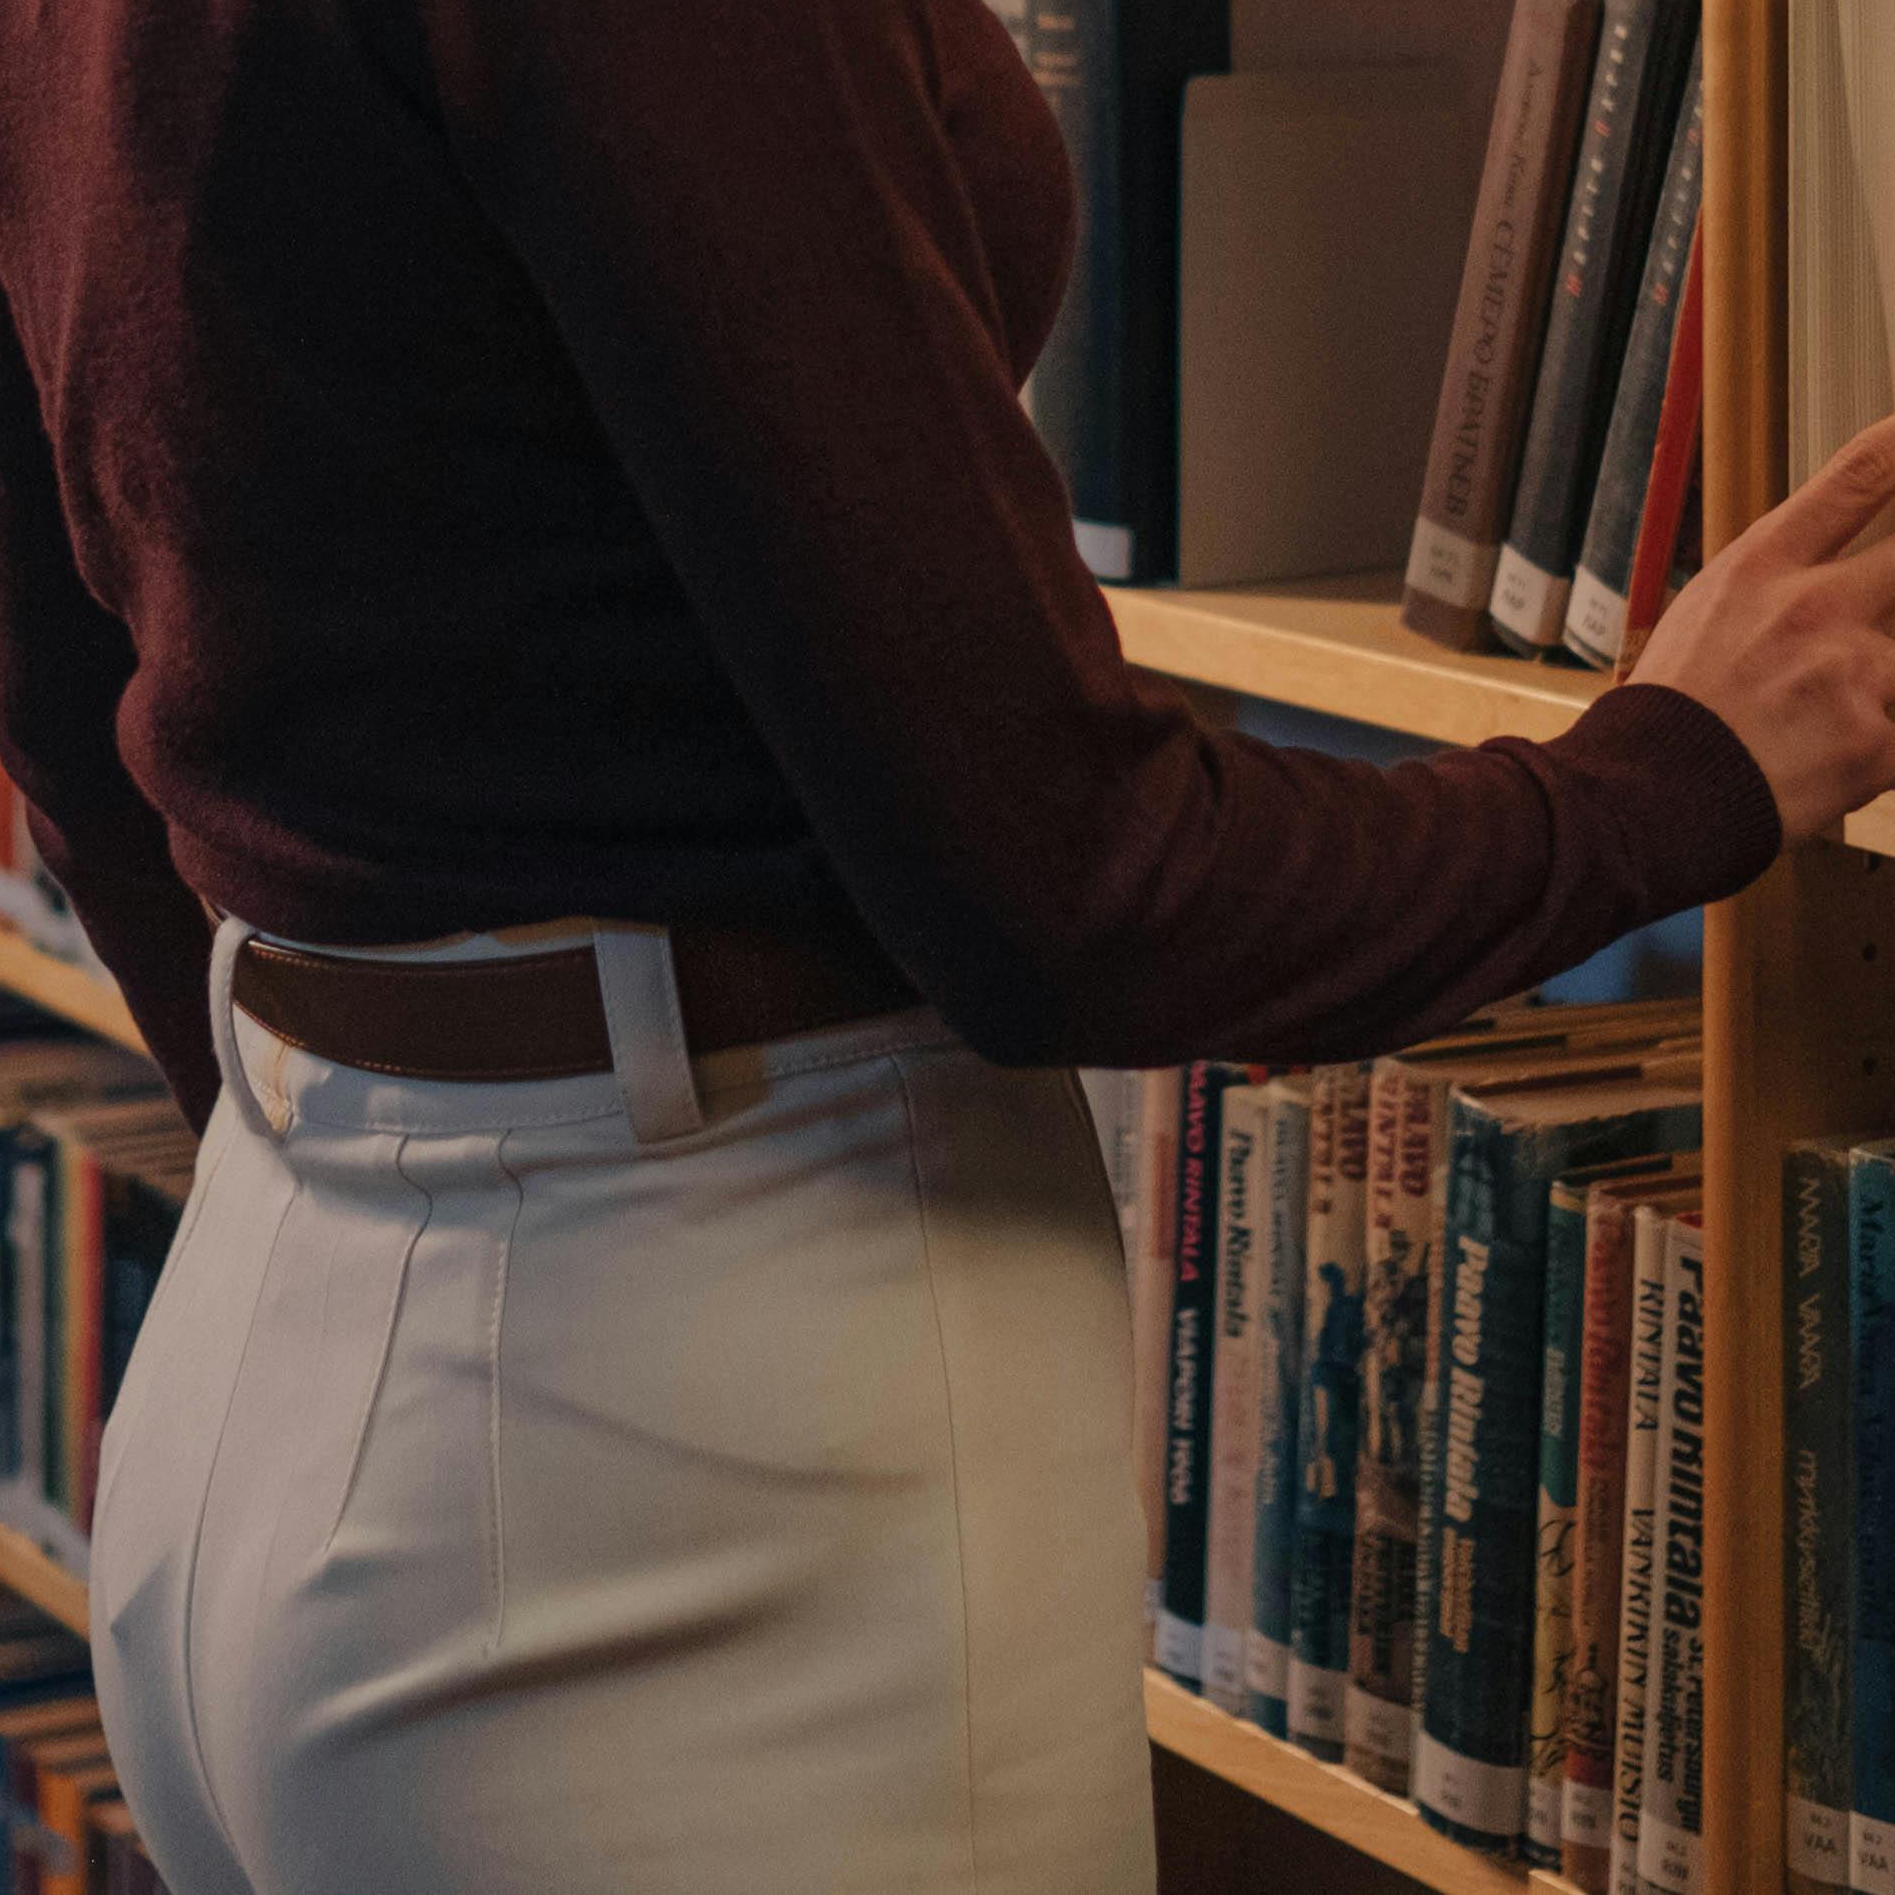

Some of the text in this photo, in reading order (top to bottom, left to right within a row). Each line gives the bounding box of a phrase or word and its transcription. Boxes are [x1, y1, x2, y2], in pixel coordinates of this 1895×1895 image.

[1443, 368, 1495, 517] БРАТЬЕВ
[1179, 1158, 1203, 1283] RINTALA
[1224, 1223, 1254, 1338] Rintala
[1451, 1233, 1490, 1365] Paavo
[1633, 1278, 1667, 1432] RINTALA
[1797, 1292, 1820, 1389] VAARA
[1444, 1365, 1484, 1522] Rintala
